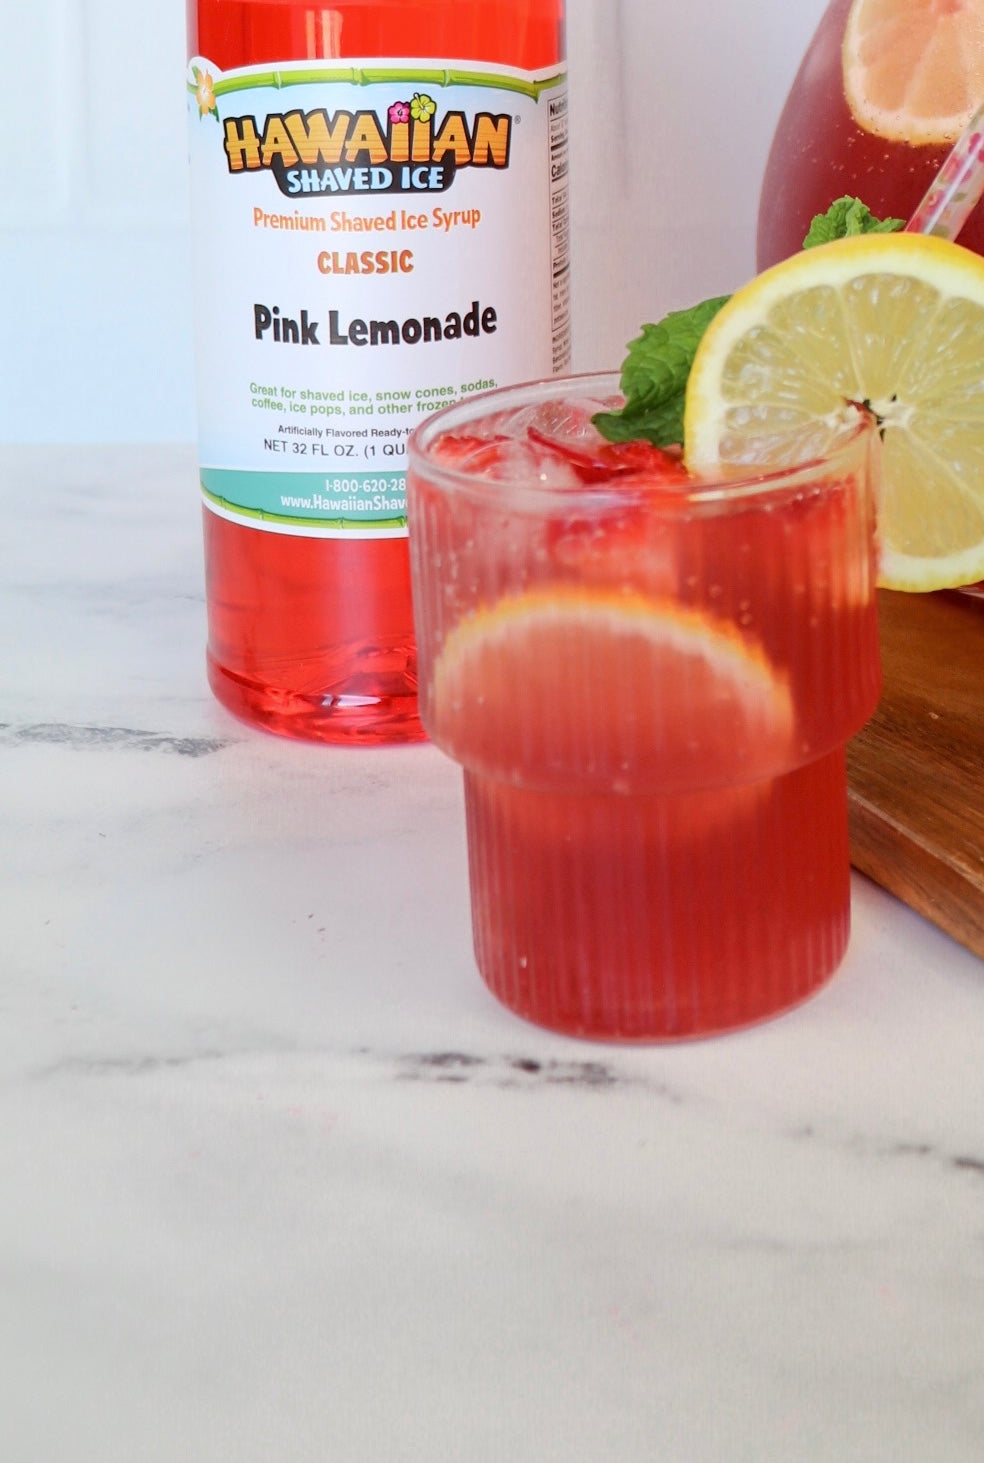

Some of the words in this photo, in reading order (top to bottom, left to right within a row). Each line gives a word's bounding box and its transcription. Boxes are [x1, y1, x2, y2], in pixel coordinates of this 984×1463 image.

[223, 93, 512, 174] HAWAIIAN
[286, 167, 393, 193] SHAVED
[400, 166, 444, 190] ICE
[253, 207, 326, 232] Premium
[330, 211, 396, 232] Shaved
[401, 211, 428, 230] Ice
[432, 207, 481, 233] Syrup
[317, 249, 414, 275] CLASSIC
[253, 303, 320, 346] Pink
[328, 300, 497, 346] Lemonade
[249, 382, 278, 397] Great
[281, 386, 297, 399] for
[300, 389, 345, 402] shaved
[349, 390, 372, 403] ice,
[376, 391, 411, 402] snow
[415, 385, 458, 399] cones,
[460, 378, 498, 394] sodas,
[251, 397, 287, 413] coffee,
[289, 400, 306, 414] ice
[310, 403, 346, 417] pops,
[349, 403, 374, 416] and
[377, 401, 413, 415] other
[278, 424, 323, 439] Artificially
[325, 428, 368, 438] Flavored
[263, 438, 289, 453] NET
[292, 442, 308, 455] 32
[312, 443, 329, 456] FL
[333, 444, 359, 457] OZ.
[364, 444, 376, 460] (1
[382, 443, 407, 456] QU
[325, 478, 407, 493] 1-800-620-28
[280, 493, 407, 512] www.HawaiianShav
